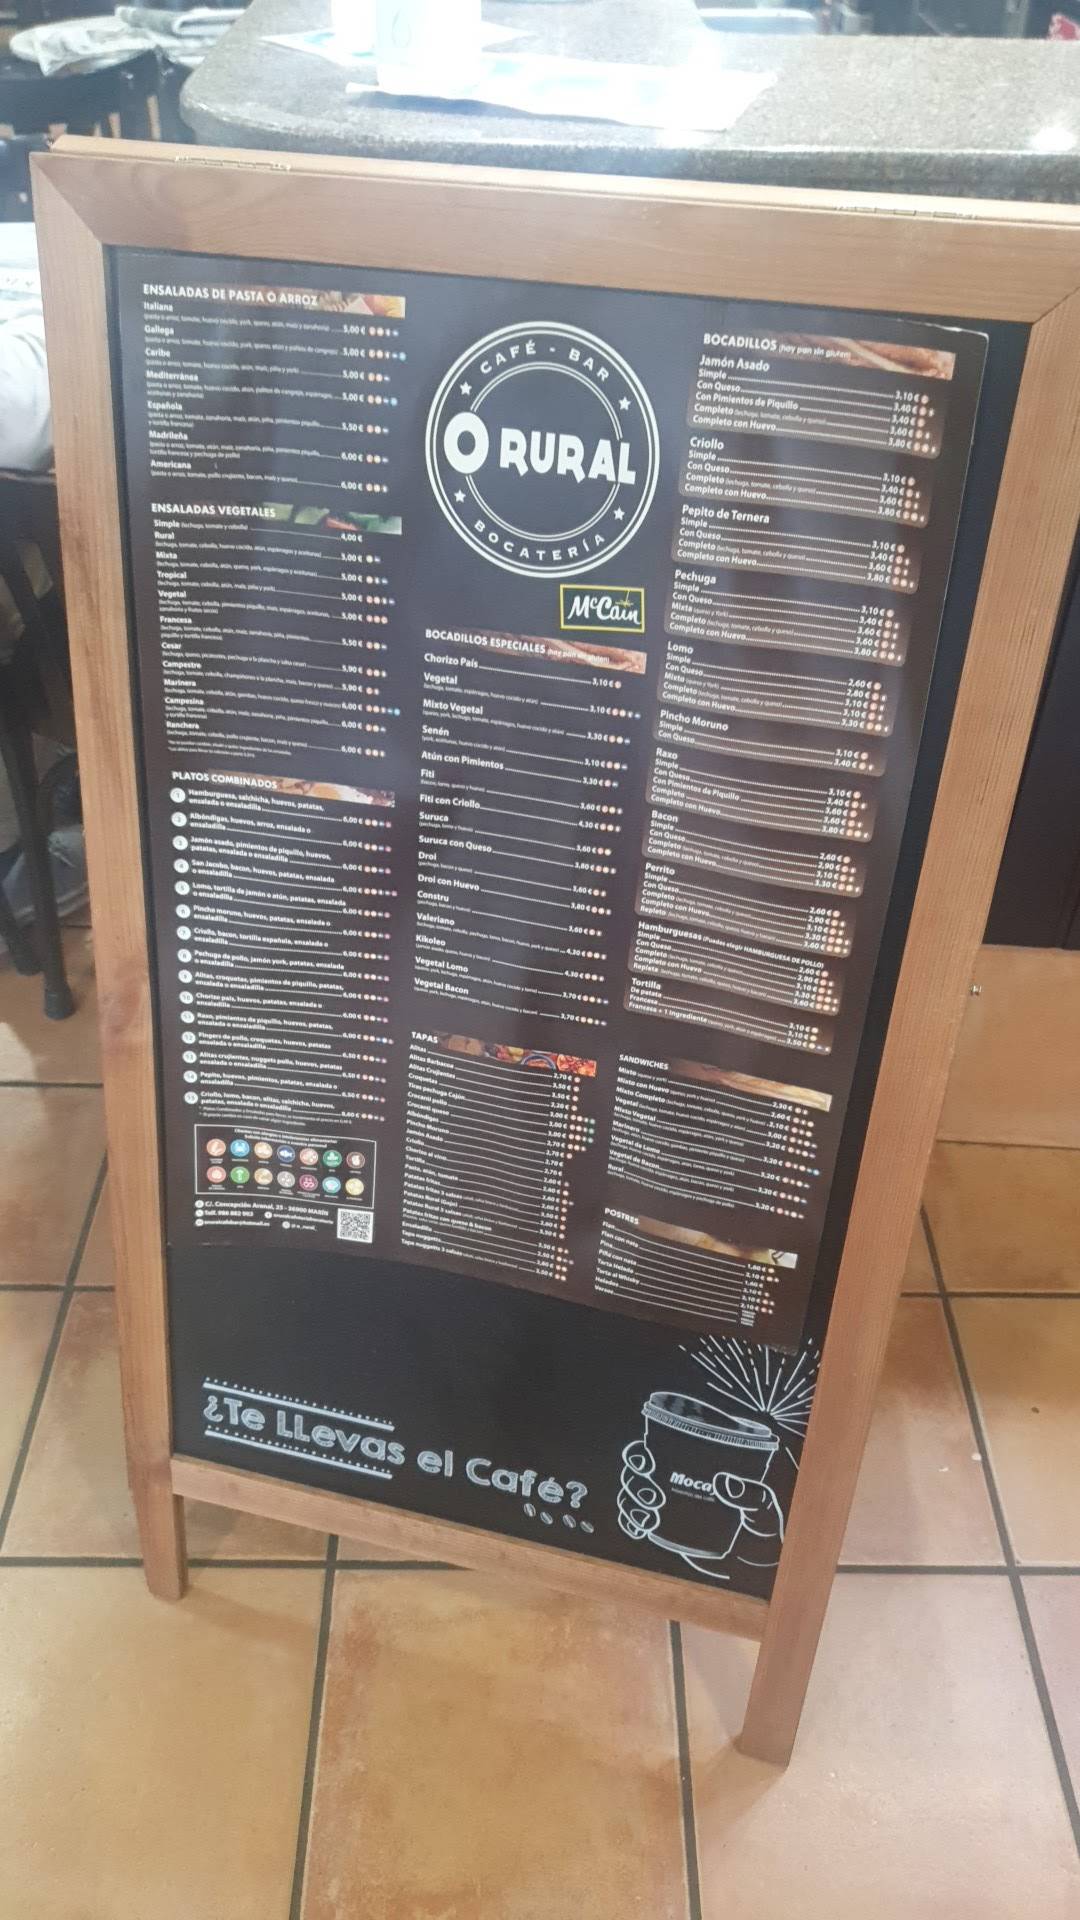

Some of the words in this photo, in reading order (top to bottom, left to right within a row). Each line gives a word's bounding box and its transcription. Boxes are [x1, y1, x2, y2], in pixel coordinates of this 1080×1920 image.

[143, 284, 209, 299] ENSALADAS
[212, 288, 226, 300] DE
[229, 289, 264, 302] PASTA
[267, 291, 276, 302] O
[279, 292, 318, 306] ARROZ
[144, 302, 173, 312] Italiana
[145, 325, 174, 336] Gallega
[703, 334, 777, 351] BOCADILLOS
[145, 348, 170, 358] Caribe
[480, 340, 536, 374] CAFÉ
[568, 348, 609, 381] BAR
[700, 355, 734, 369] Jamón
[737, 359, 770, 372] Asado
[146, 370, 198, 382] Mediterránea
[698, 369, 727, 380] Simple
[895, 391, 913, 402] 3,10
[696, 392, 711, 401] Con
[713, 394, 753, 406] Pimientos
[755, 398, 765, 407] de
[767, 399, 798, 410] Piquillo
[697, 380, 713, 390] Con
[715, 382, 741, 393] Queso
[894, 402, 911, 413] 3,40
[147, 401, 182, 412] Española
[694, 403, 734, 416] Completo
[693, 415, 732, 427] Completo
[734, 420, 748, 428] con
[750, 420, 776, 431] Huevo
[149, 430, 188, 441] Madrileña
[444, 412, 489, 474] O
[500, 427, 636, 484] RURAL
[690, 437, 724, 449] Criollo
[151, 460, 191, 470] Americana
[687, 461, 703, 471] Con
[705, 463, 730, 474] Queso
[688, 450, 716, 462] Simple
[883, 472, 900, 483] 3,10
[686, 472, 725, 485] Completo
[685, 484, 721, 497] Completo
[723, 489, 739, 498] con
[741, 490, 767, 500] Huevo
[151, 503, 216, 515] ENSALADAS
[218, 505, 276, 518] VEGETALES
[682, 504, 715, 520] Pepito
[716, 509, 730, 520] de
[731, 510, 770, 524] Ternera
[154, 520, 180, 529] Simple
[154, 532, 175, 540] Rural
[474, 519, 605, 561] BOCATERÍA
[680, 529, 695, 538] Con
[697, 530, 721, 540] Queso
[681, 517, 708, 528] Simple
[872, 540, 890, 550] 3,10
[678, 539, 716, 551] Completo
[156, 552, 177, 560] Mixta
[677, 550, 715, 562] Completo
[716, 554, 730, 564] con
[731, 555, 757, 566] Huevo
[157, 571, 187, 580] Tropical
[674, 569, 717, 585] Pechuga
[158, 590, 186, 600] Vegetal
[672, 592, 687, 601] Con
[688, 594, 713, 604] Queso
[674, 582, 700, 593] Simple
[861, 605, 879, 615] 3,10
[567, 595, 641, 625] McCain
[160, 616, 192, 624] Francesa
[161, 642, 181, 650] Cesar
[425, 629, 488, 646] BOCADILLOS
[490, 638, 546, 654] ESPECIALES
[667, 641, 694, 655] Lomo
[667, 653, 691, 664] Simple
[162, 661, 201, 671] Campestre
[424, 653, 458, 665] Chorizo
[460, 657, 478, 669] País
[592, 678, 608, 687] 3,10
[665, 663, 680, 672] Con
[682, 665, 704, 676] Queso
[164, 679, 196, 687] Marinera
[424, 672, 458, 685] Vegetal
[165, 697, 204, 707] Campesina
[423, 699, 448, 710] Mixto
[450, 702, 483, 715] Vegetal
[166, 721, 199, 729] Ranchera
[659, 721, 683, 732] Simple
[660, 710, 691, 724] Pincho
[692, 716, 728, 731] Moruno
[422, 725, 449, 736] Senén
[421, 751, 442, 762] Atún
[444, 755, 460, 764] con
[461, 756, 504, 770] Pimientos
[172, 771, 209, 782] PLATOS
[211, 774, 277, 789] COMBINADOS
[435, 798, 451, 807] con
[452, 796, 480, 809] Criollo
[419, 812, 449, 822] Suruca
[652, 810, 678, 823] Bacon
[419, 835, 448, 848] Suruca
[450, 840, 464, 849] con
[466, 841, 492, 853] Queso
[645, 862, 675, 875] Perrito
[438, 878, 452, 887] con
[454, 880, 480, 891] Huevo
[417, 890, 449, 902] Constru
[417, 913, 455, 926] Valeriano
[416, 935, 446, 946] Kikoleo
[638, 921, 702, 940] Hamburguesas
[744, 945, 790, 962] HAMBURGUESA
[415, 956, 445, 969] Vegetal
[446, 962, 468, 973] Lomo
[414, 978, 444, 990] Vegetal
[445, 983, 469, 995] Bacon
[632, 978, 662, 990] Tortilla
[641, 989, 662, 999] patata
[412, 1031, 438, 1044] TAPAS
[619, 1054, 669, 1070] SANDWICHES
[604, 1208, 639, 1225] POSTRES
[203, 1396, 266, 1431] ¿Te
[277, 1410, 405, 1464] LLevas
[417, 1450, 453, 1476] el
[466, 1458, 588, 1508] Café?
[670, 1472, 714, 1496] Moca
